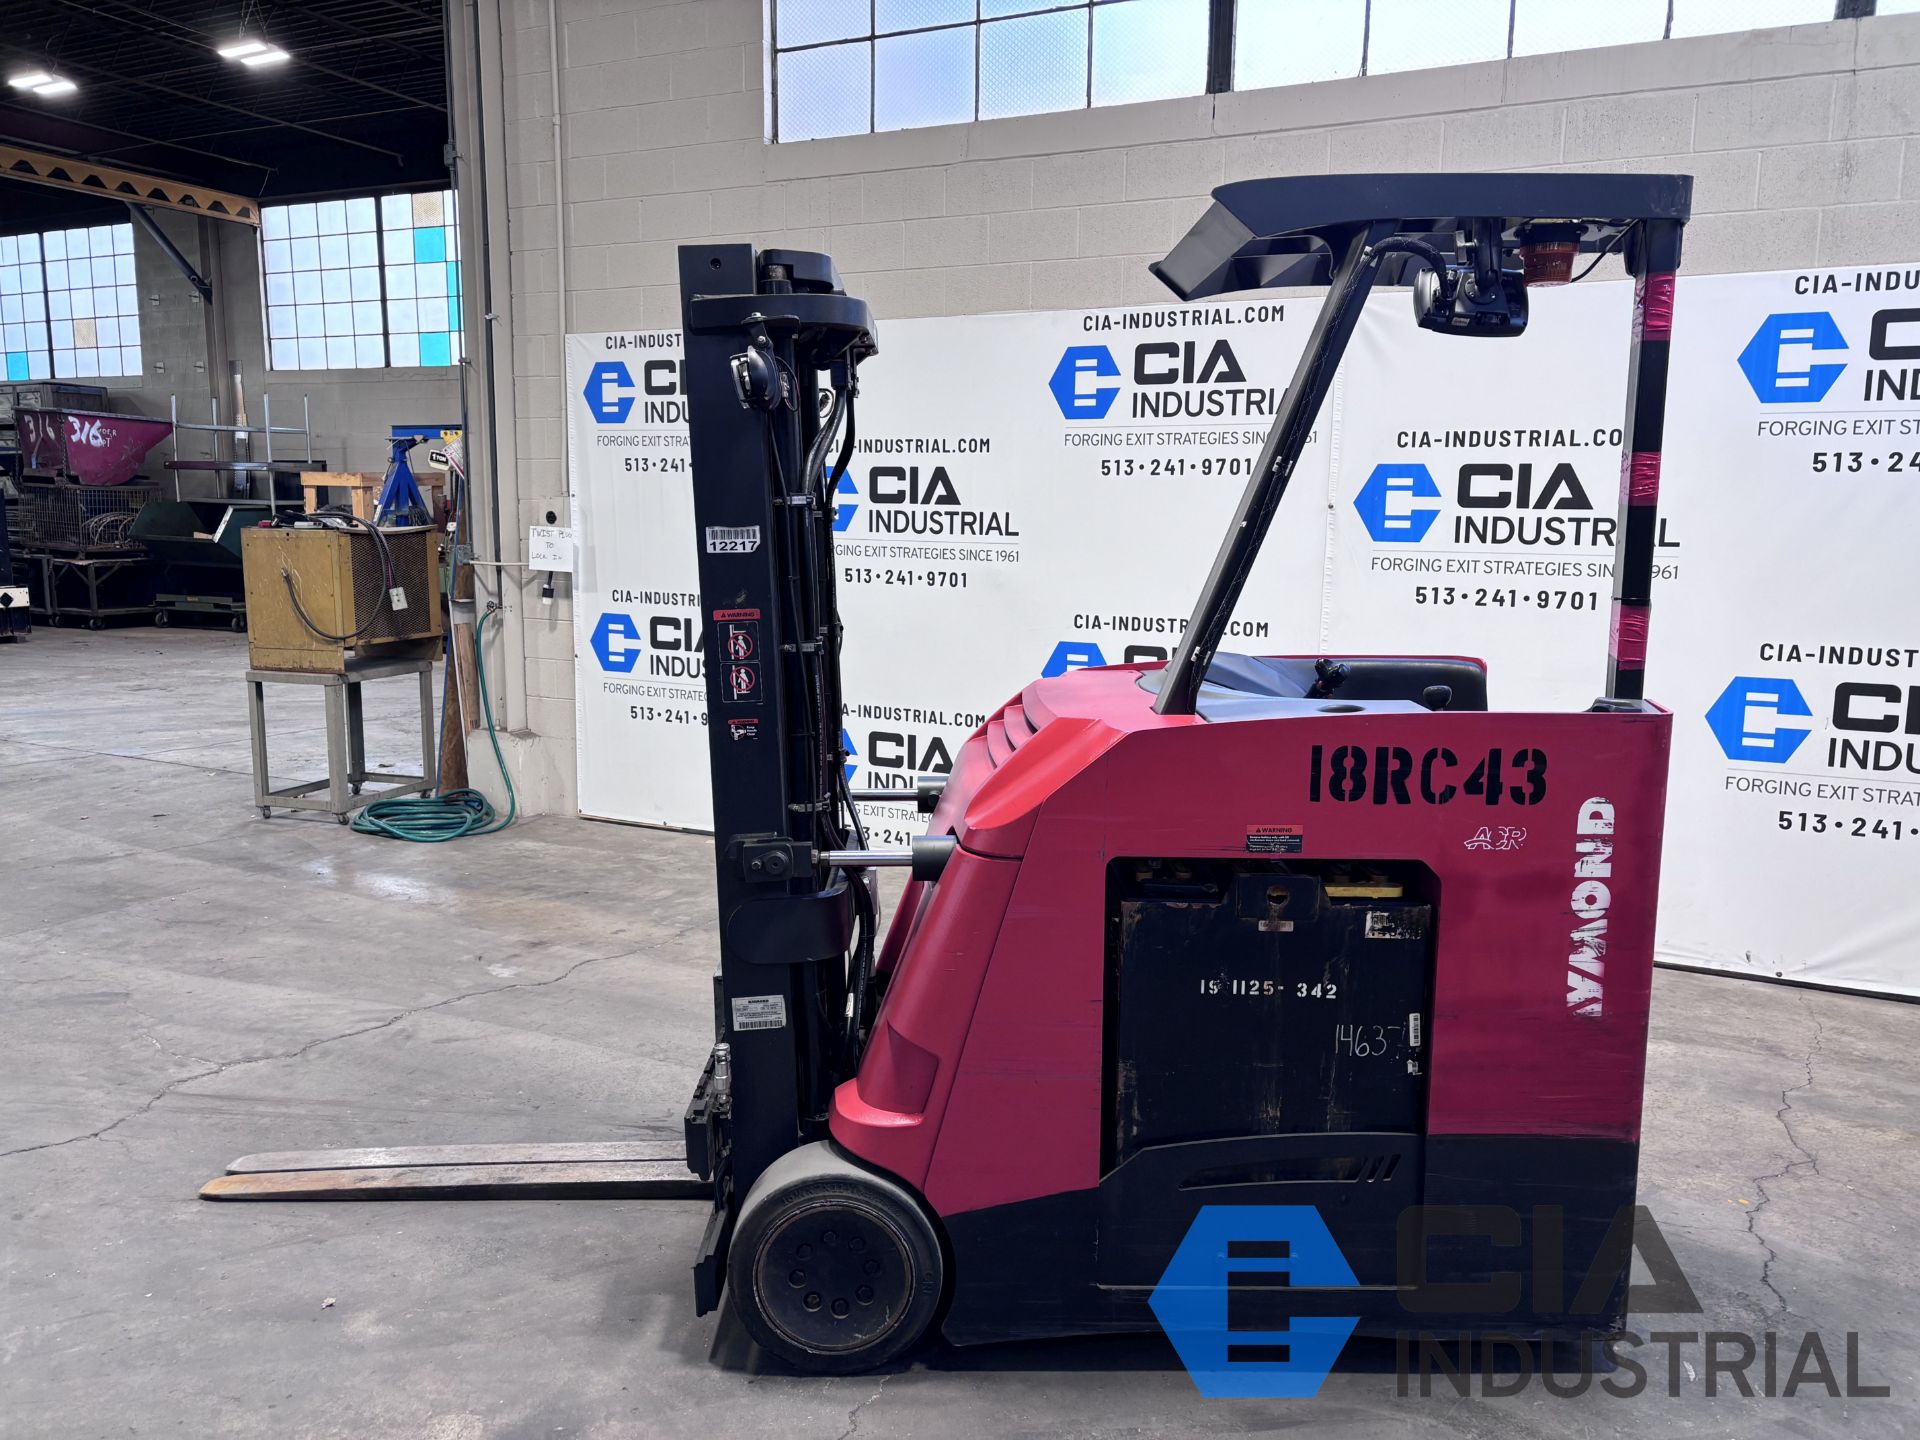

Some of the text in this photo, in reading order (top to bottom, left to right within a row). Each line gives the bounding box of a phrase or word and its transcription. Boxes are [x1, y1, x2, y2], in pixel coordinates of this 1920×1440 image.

[1083, 305, 1285, 332] CIA-INDUSTRIAL.COM
[1133, 339, 1247, 386] CIA
[68, 415, 102, 447] 316
[1064, 433, 1123, 447] FORGING
[1126, 433, 1155, 446] EXIT
[1157, 431, 1239, 446] STRATEGIES
[1758, 420, 1847, 437] FORGING
[1852, 419, 1896, 436] EXIT
[597, 435, 639, 447] FORGING
[642, 435, 662, 447] EXIT
[869, 466, 961, 505] CIA
[1457, 462, 1594, 510] CIA
[868, 509, 1019, 536] INDUSTRIAL
[1454, 515, 1681, 548] INDUSTRL
[709, 540, 758, 552] 12217
[864, 545, 887, 557] EXIT
[890, 546, 956, 560] STRATEGIES
[958, 549, 992, 562] SINCE
[995, 550, 1019, 562] 1961
[1371, 557, 1442, 573] FORGING
[1446, 559, 1481, 574] EXIT
[1483, 560, 1582, 577] STRATEGIES
[603, 682, 645, 696] FORGING
[647, 686, 667, 698] EXIT
[868, 731, 953, 774] CIA
[1309, 744, 1548, 806] 18RC43
[1725, 776, 1811, 797] FORGING
[1817, 783, 1859, 801] EXIT
[863, 804, 886, 817] EXIT
[1297, 982, 1338, 999] 342
